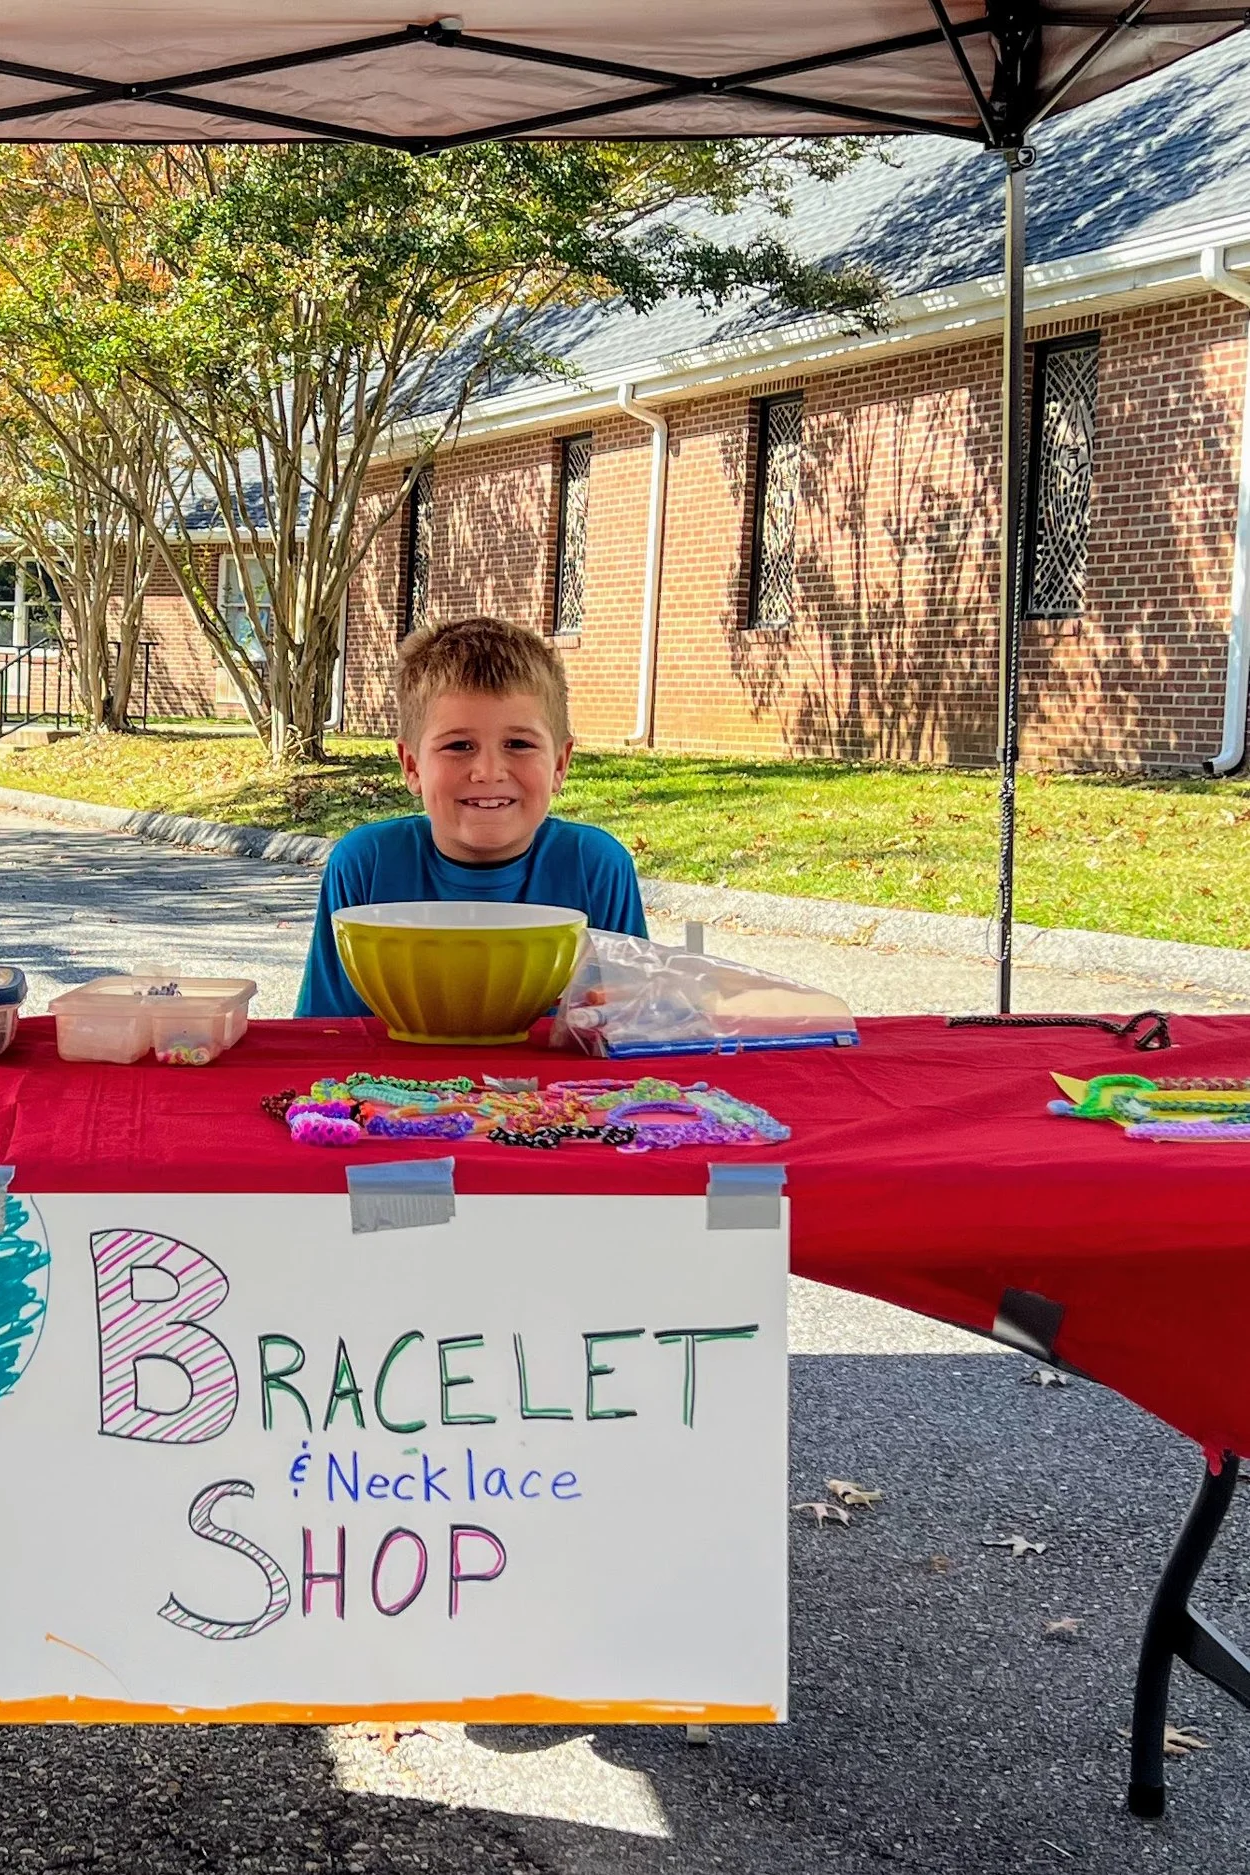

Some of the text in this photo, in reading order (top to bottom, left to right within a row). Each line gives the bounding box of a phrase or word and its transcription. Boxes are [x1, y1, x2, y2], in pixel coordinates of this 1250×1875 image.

[89, 1227, 759, 1445] BRACELET
[326, 1449, 582, 1503] Necklace
[156, 1479, 507, 1641] SHOP
